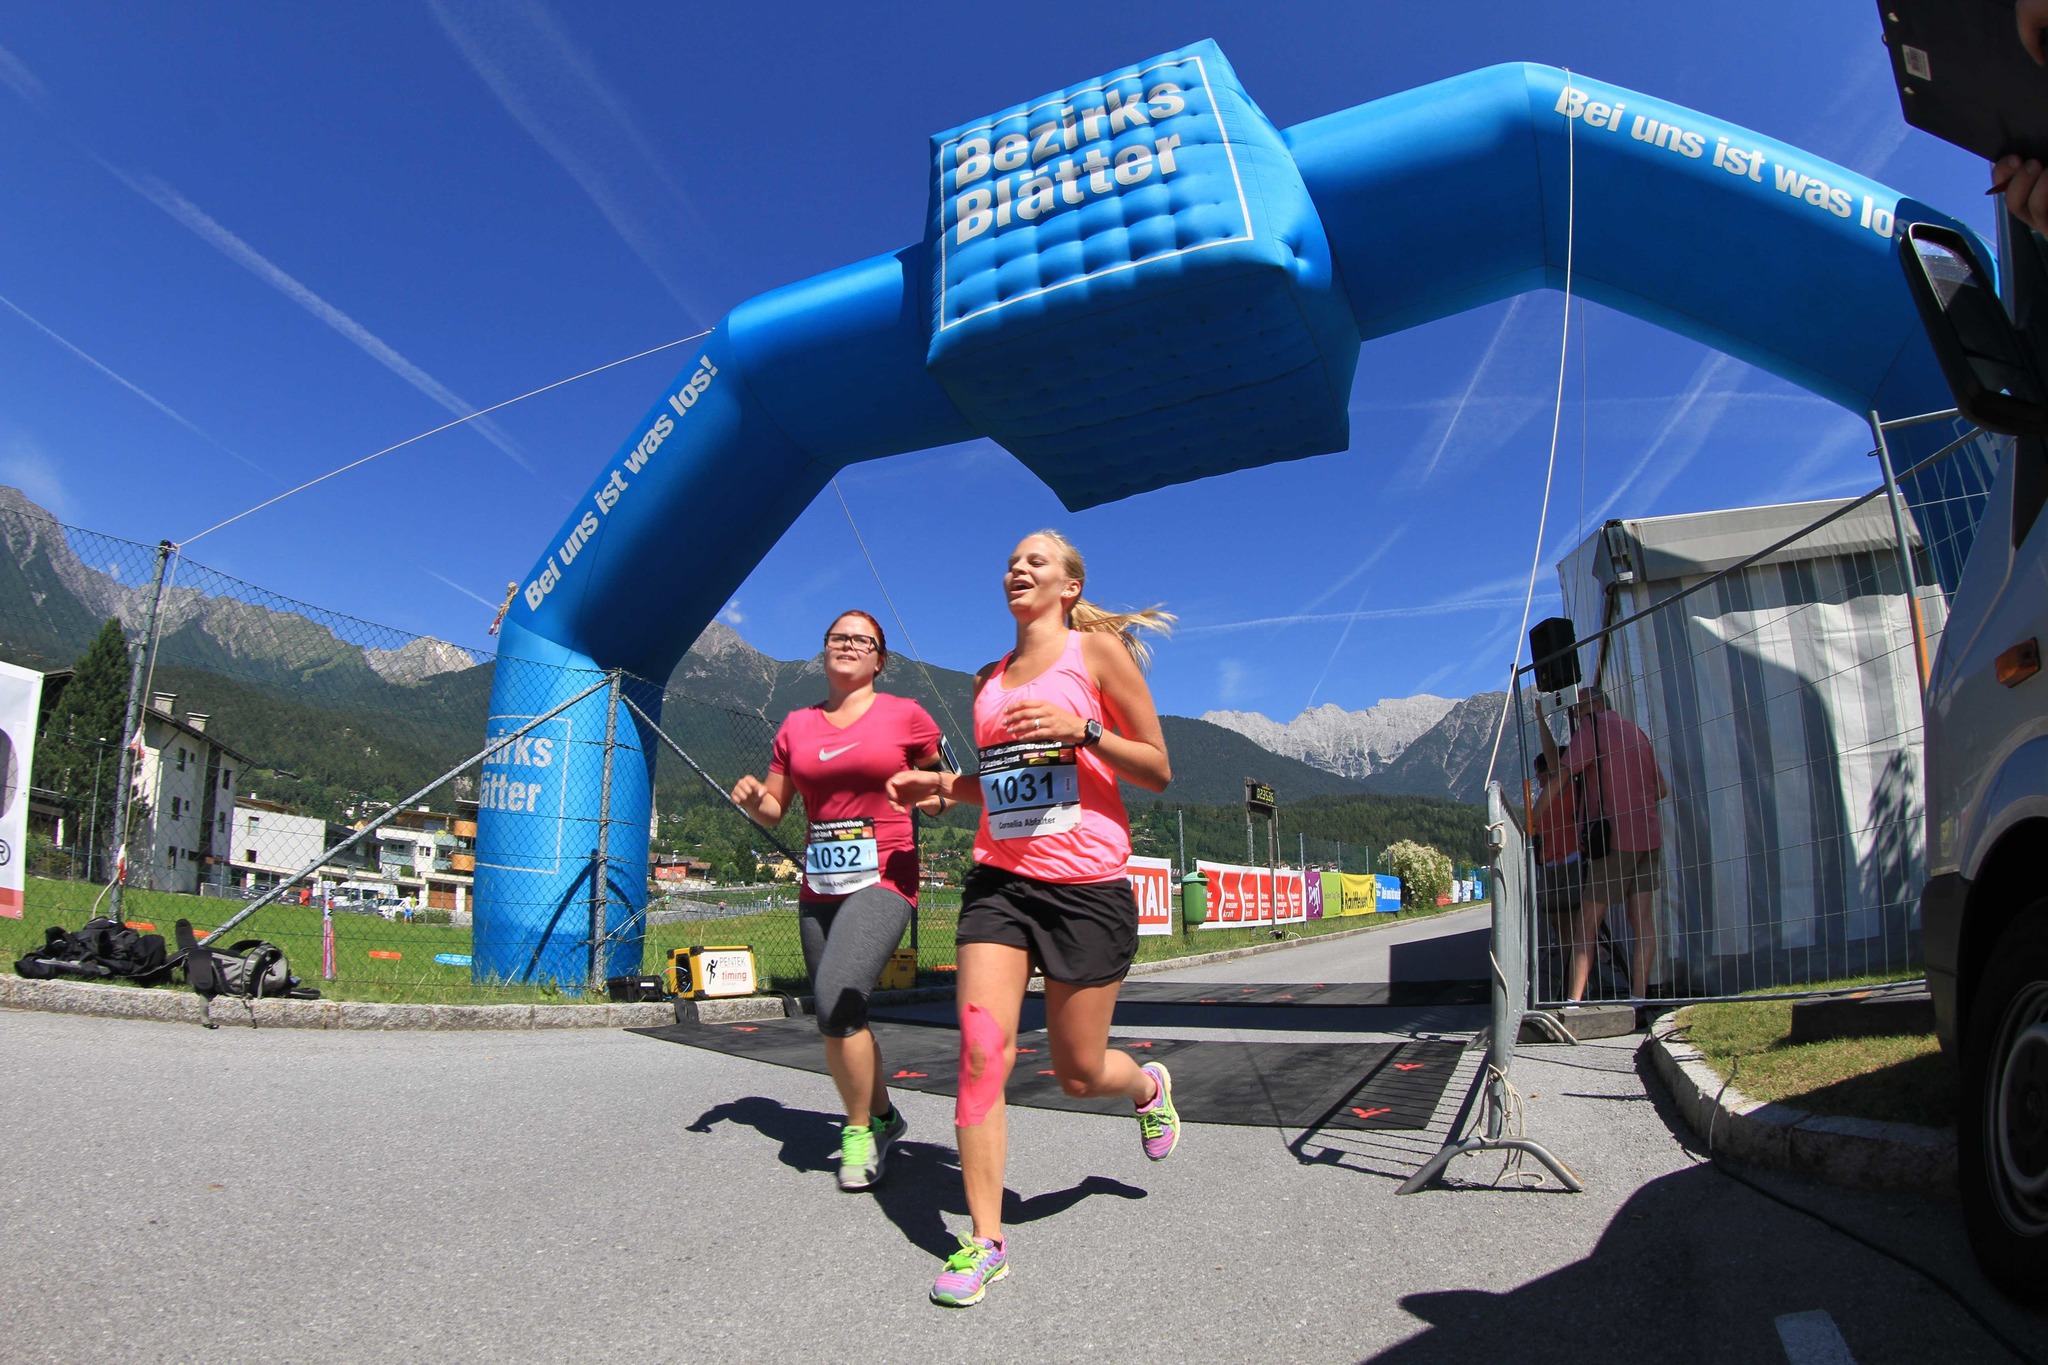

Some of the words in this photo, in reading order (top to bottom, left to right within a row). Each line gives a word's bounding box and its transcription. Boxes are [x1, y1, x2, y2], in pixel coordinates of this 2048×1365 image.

[956, 82, 1185, 190] Bezirks
[1554, 86, 1625, 133] Bei
[1630, 115, 1706, 159] uns
[1713, 136, 1765, 183] ist
[1774, 164, 1852, 218] was
[957, 133, 1181, 245] Blätter
[524, 556, 562, 611] Bei
[559, 511, 599, 565] uns
[594, 469, 629, 515] ist
[624, 413, 674, 474] was
[669, 355, 718, 416] los!
[991, 772, 1053, 805] 1031
[814, 845, 861, 870] 1032
[719, 957, 746, 966] PENTEK
[722, 971, 747, 981] timing
